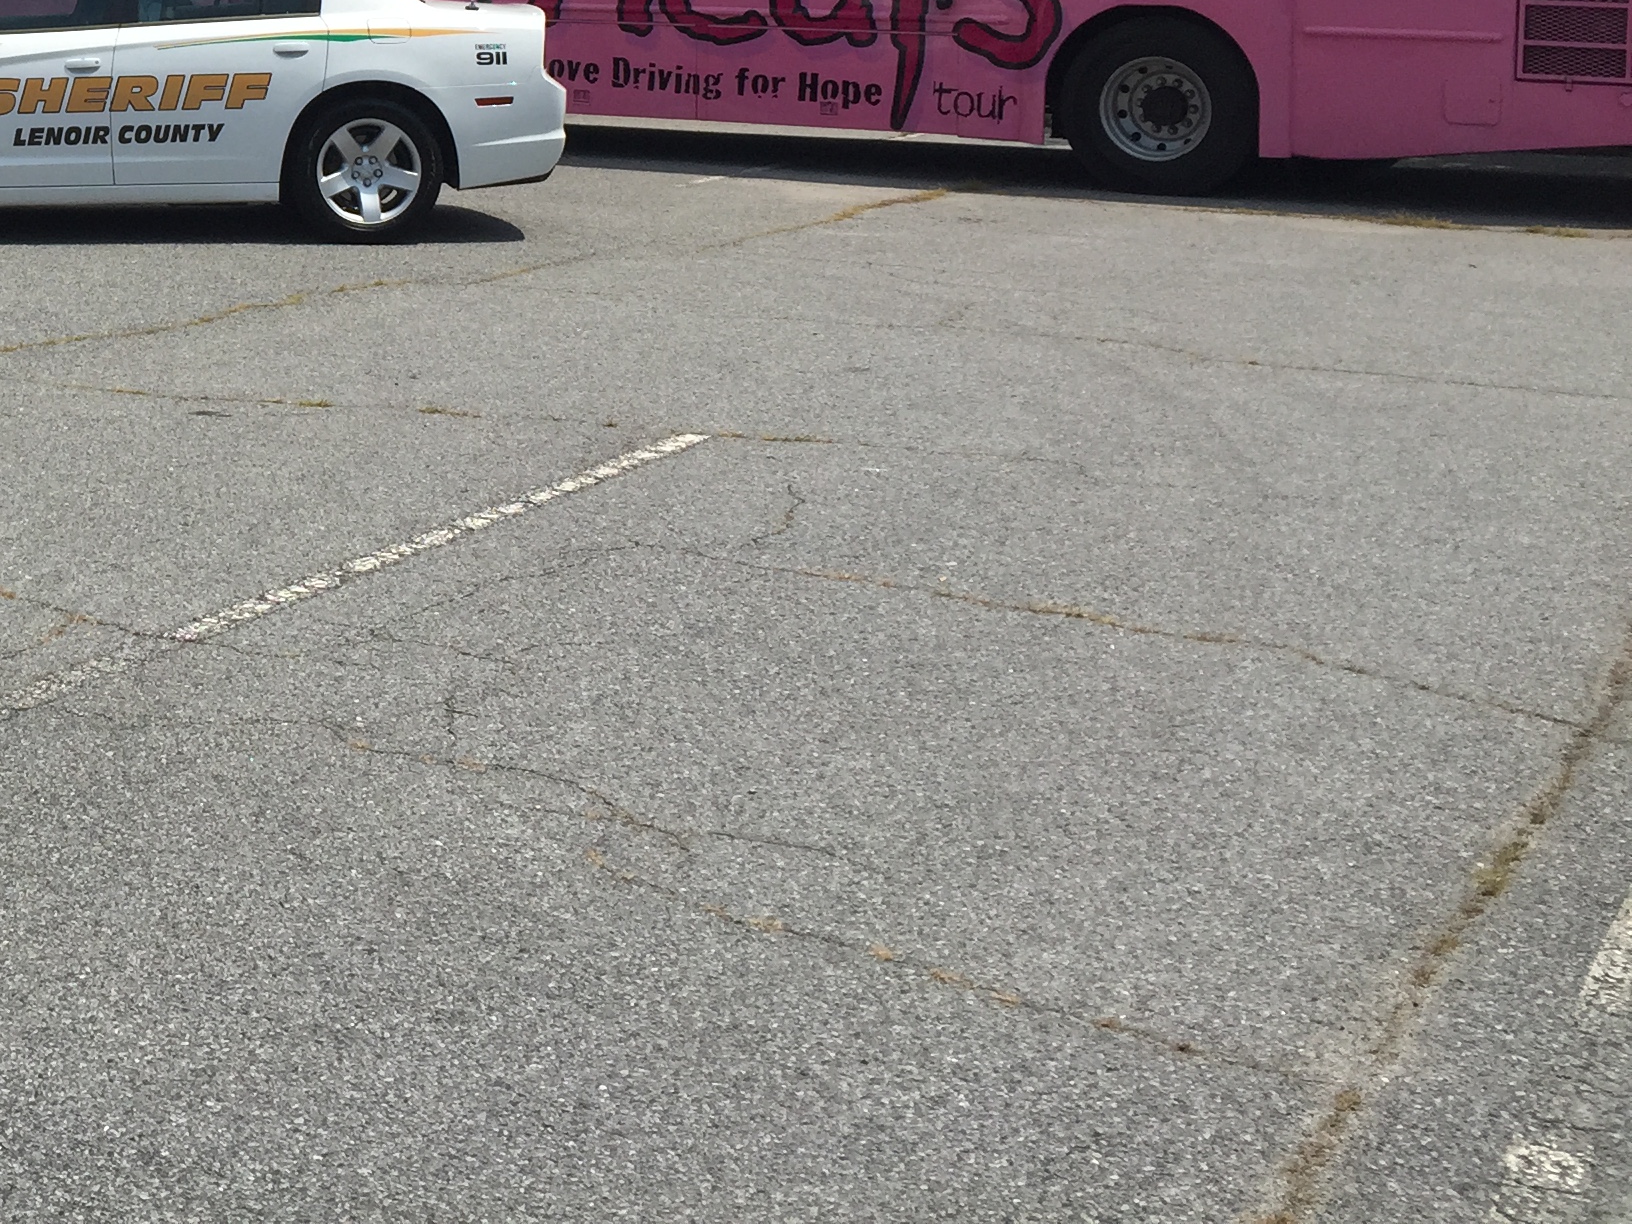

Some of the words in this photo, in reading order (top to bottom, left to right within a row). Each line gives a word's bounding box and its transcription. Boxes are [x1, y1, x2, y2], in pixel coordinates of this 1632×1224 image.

[475, 51, 508, 66] 911
[548, 59, 600, 85] ove
[611, 56, 722, 101] Driving
[735, 67, 787, 99] for
[798, 71, 883, 107] Hope
[932, 79, 1017, 123] tour
[13, 126, 111, 147] LENOIR
[117, 122, 225, 145] COUNTY
